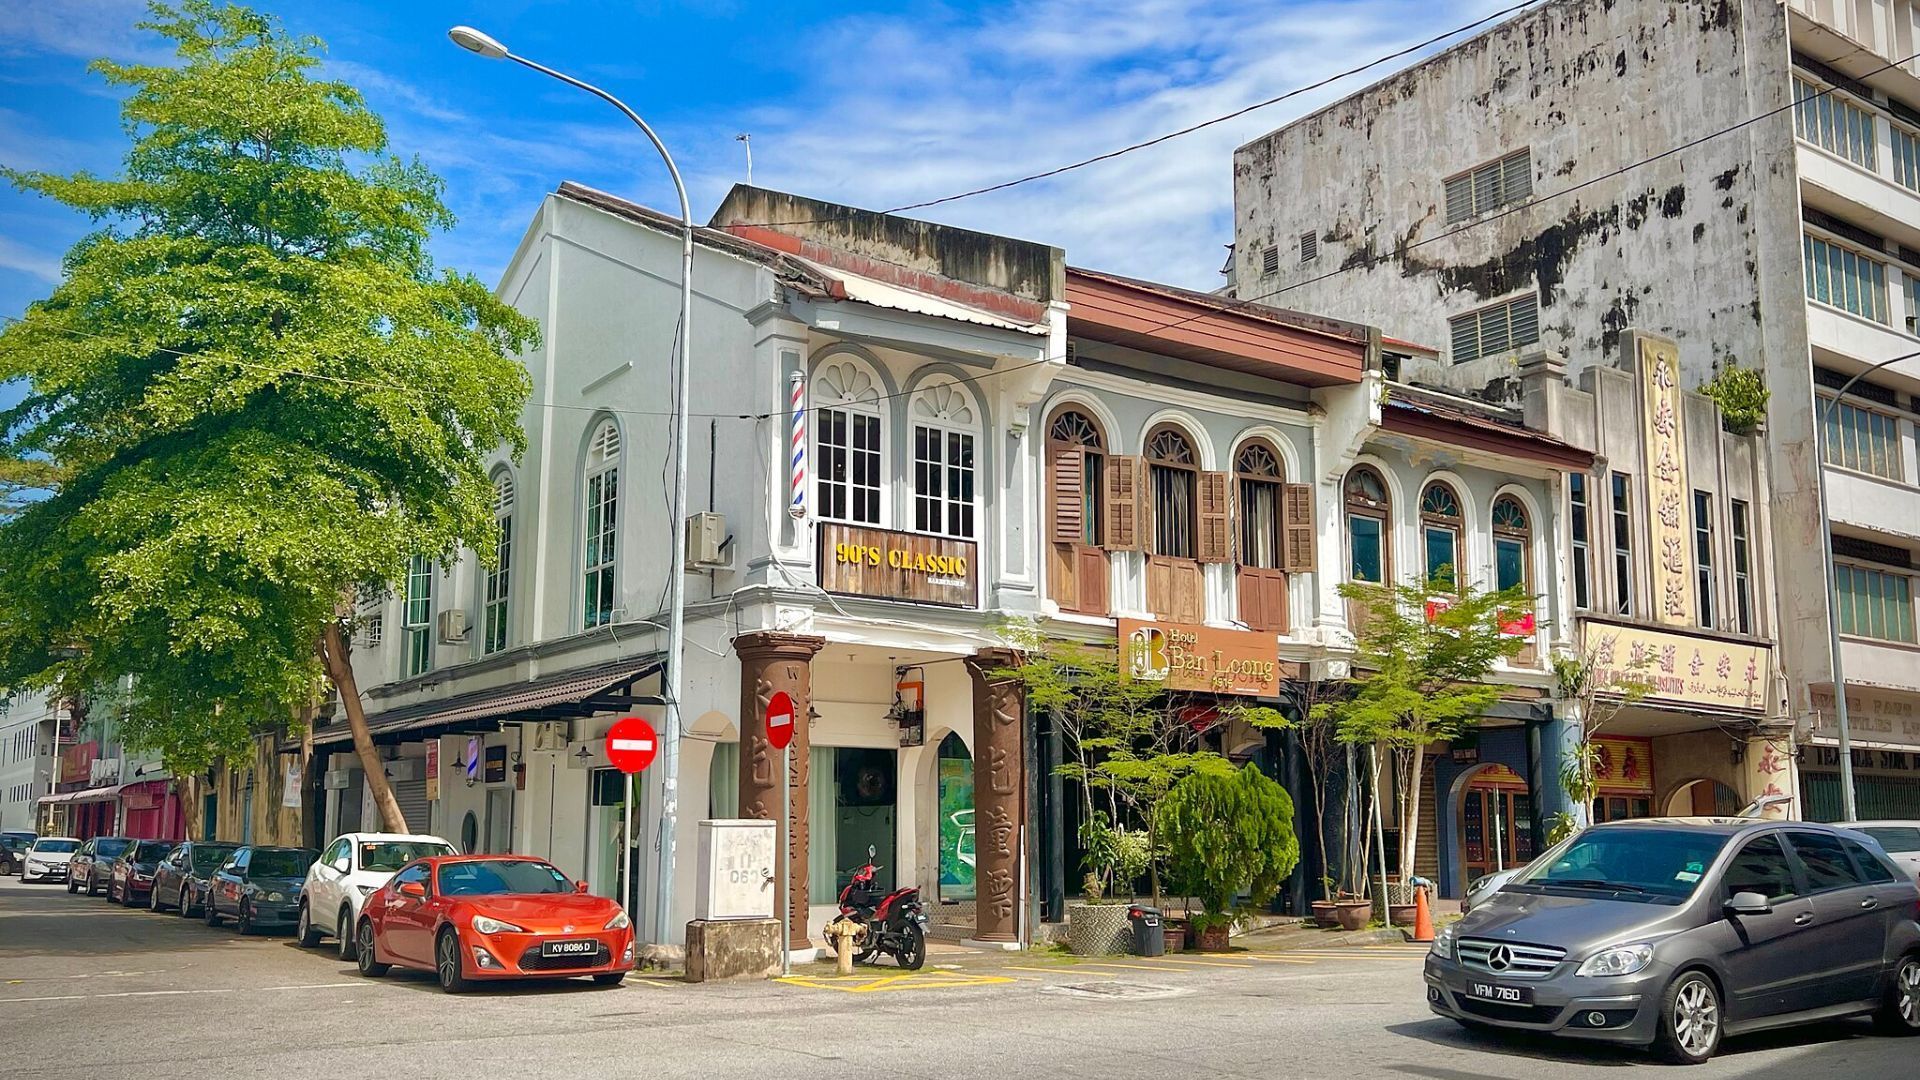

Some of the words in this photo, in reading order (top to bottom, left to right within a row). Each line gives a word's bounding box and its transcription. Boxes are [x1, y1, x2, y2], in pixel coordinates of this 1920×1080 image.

[836, 543, 880, 566] 90'S
[888, 549, 967, 577] CLASSIC
[1169, 628, 1198, 644] Hotel
[1170, 646, 1208, 671] Ban
[1214, 650, 1274, 682] Loong
[552, 944, 563, 953] KV
[584, 943, 591, 951] D
[1474, 983, 1493, 998] VFM
[1495, 986, 1520, 1001] 7160
